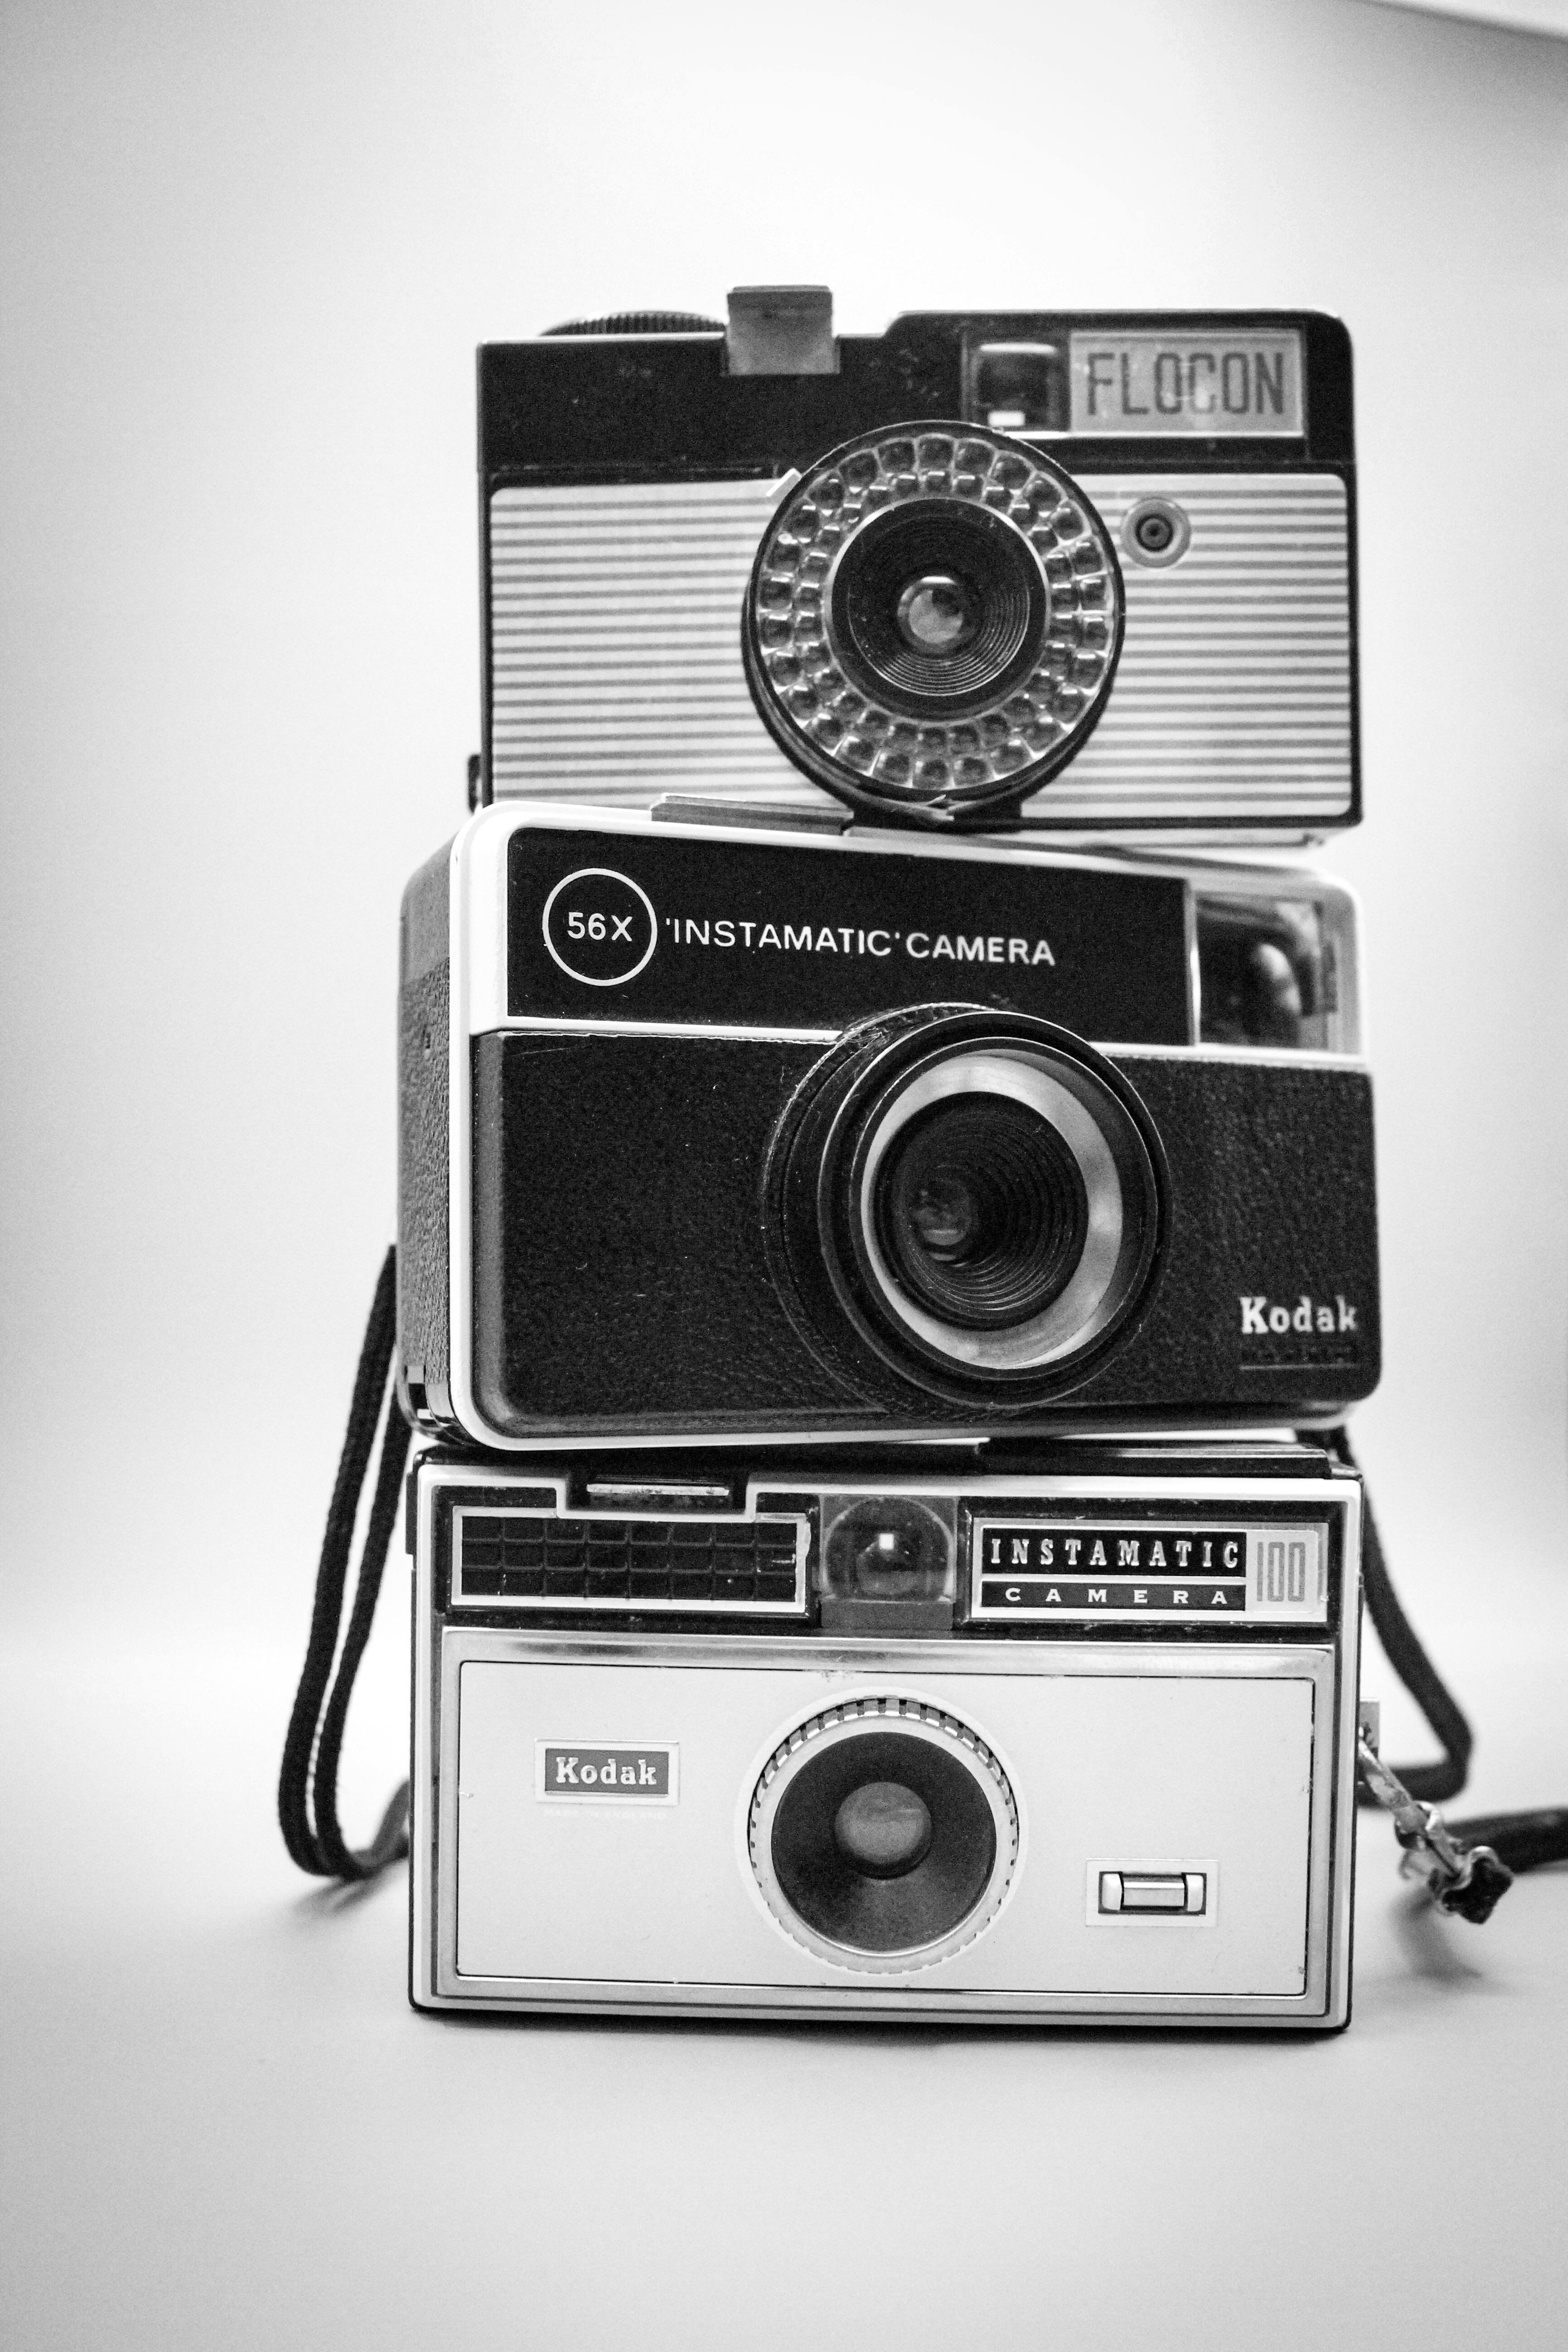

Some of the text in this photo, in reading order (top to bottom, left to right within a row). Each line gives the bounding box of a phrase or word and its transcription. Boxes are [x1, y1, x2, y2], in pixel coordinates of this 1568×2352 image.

[1088, 352, 1284, 415] FLOCON
[567, 911, 632, 942] 56X
[906, 932, 1055, 966] CAMERA
[1240, 1295, 1357, 1334] Kodak
[990, 1539, 1306, 1602] INSTAMATIC 100
[1005, 1588, 1228, 1605] CAMERA
[555, 1756, 657, 1785] Kodak
